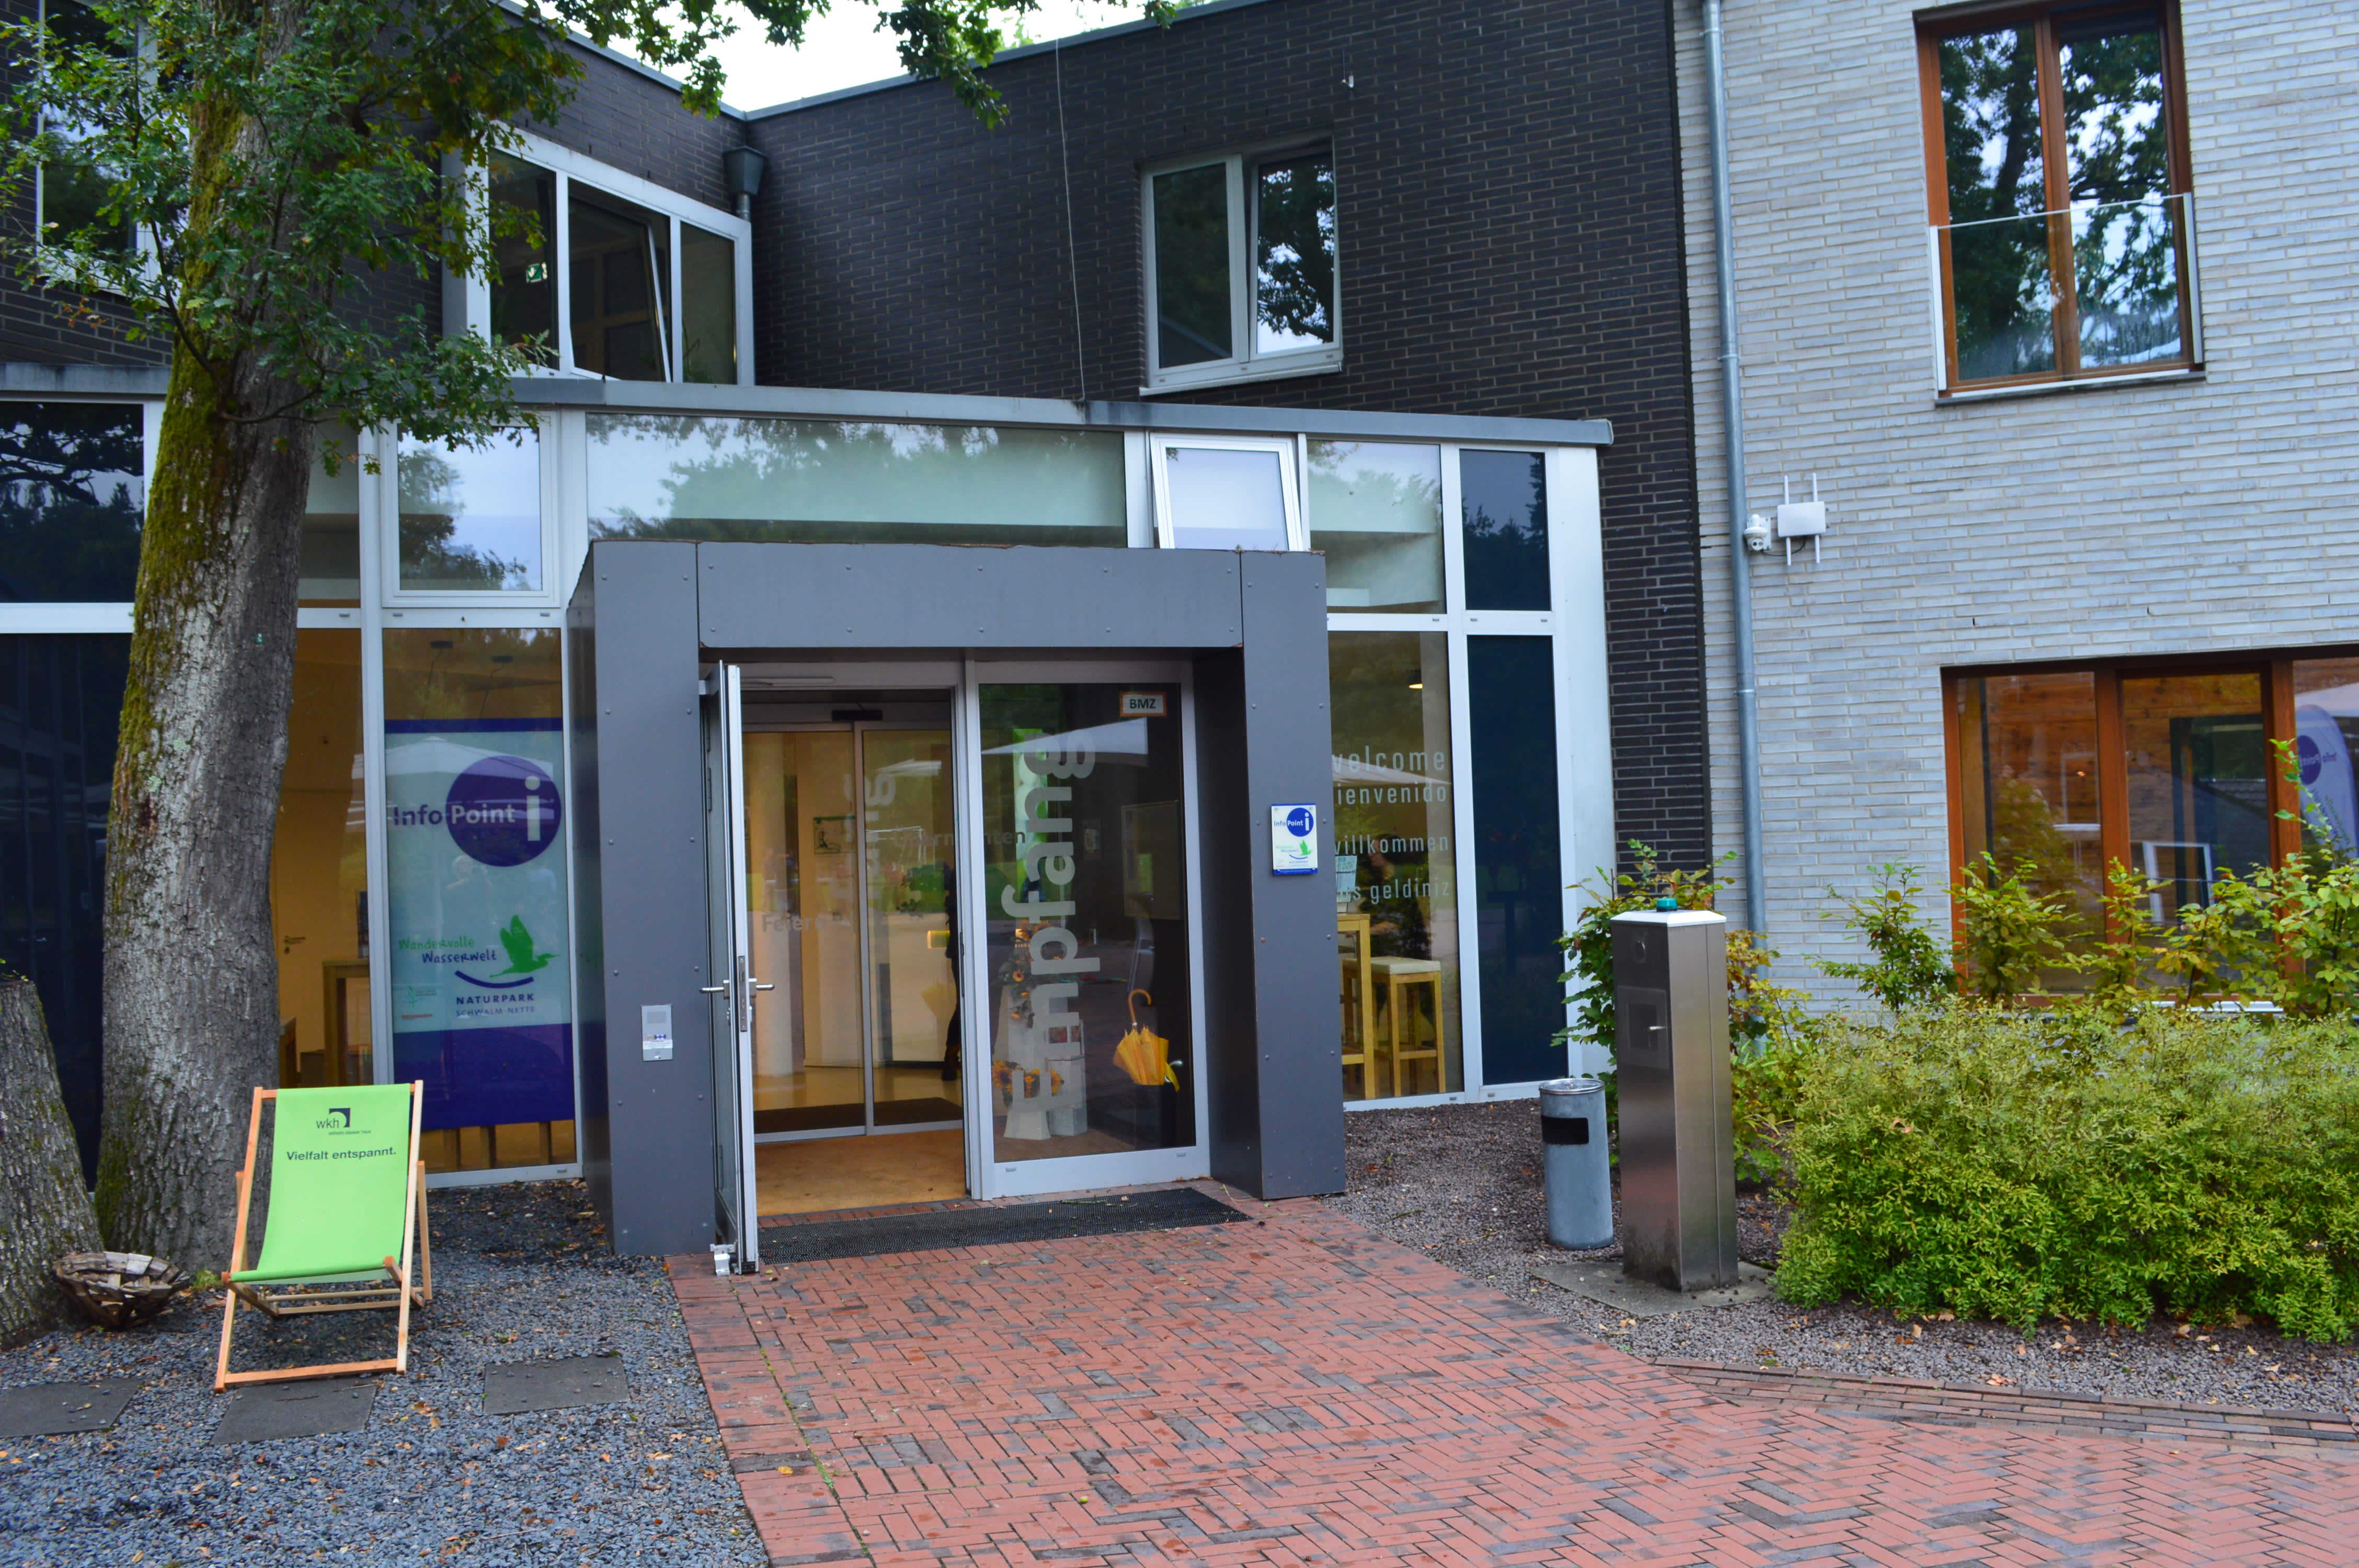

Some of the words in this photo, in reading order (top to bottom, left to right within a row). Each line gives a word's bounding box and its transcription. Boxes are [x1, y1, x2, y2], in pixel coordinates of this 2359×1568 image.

[1129, 698, 1156, 709] BMZ
[1337, 781, 1447, 805] ienvenido
[394, 804, 443, 826] Info
[451, 803, 516, 824] Point
[1370, 877, 1450, 905] geldiniz
[1001, 731, 1101, 1113] Empfang
[456, 994, 534, 1005] NATURPARK
[455, 1006, 535, 1017] SCHWALM-NETTE
[316, 1117, 339, 1129] wkh
[287, 1150, 329, 1161] Vielfalt
[332, 1146, 397, 1160] entspannt.
